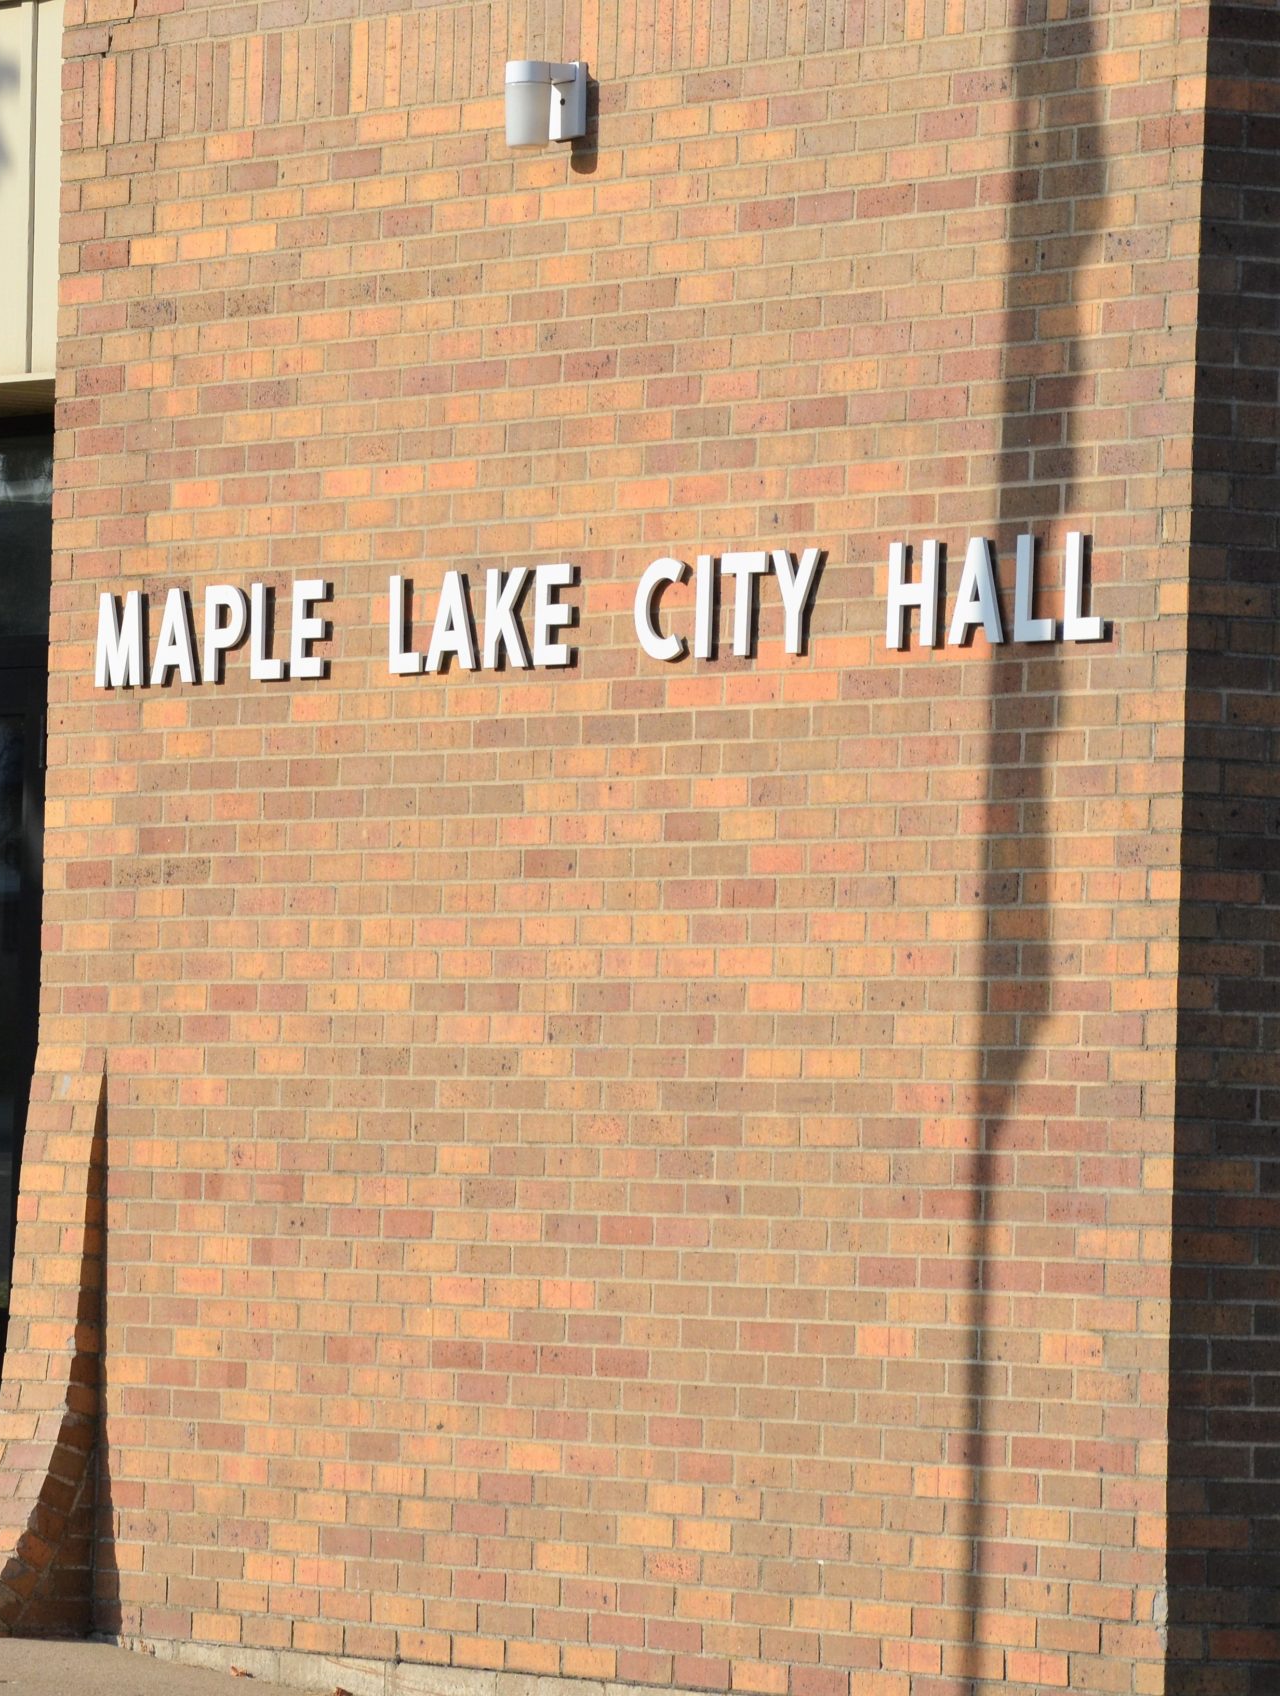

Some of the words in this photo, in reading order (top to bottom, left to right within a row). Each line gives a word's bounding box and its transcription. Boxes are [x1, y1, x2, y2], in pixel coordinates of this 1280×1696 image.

[94, 579, 328, 689] MAPLE
[388, 563, 577, 676] LAKE
[633, 548, 822, 660] CITY
[885, 531, 1107, 649] HALL
